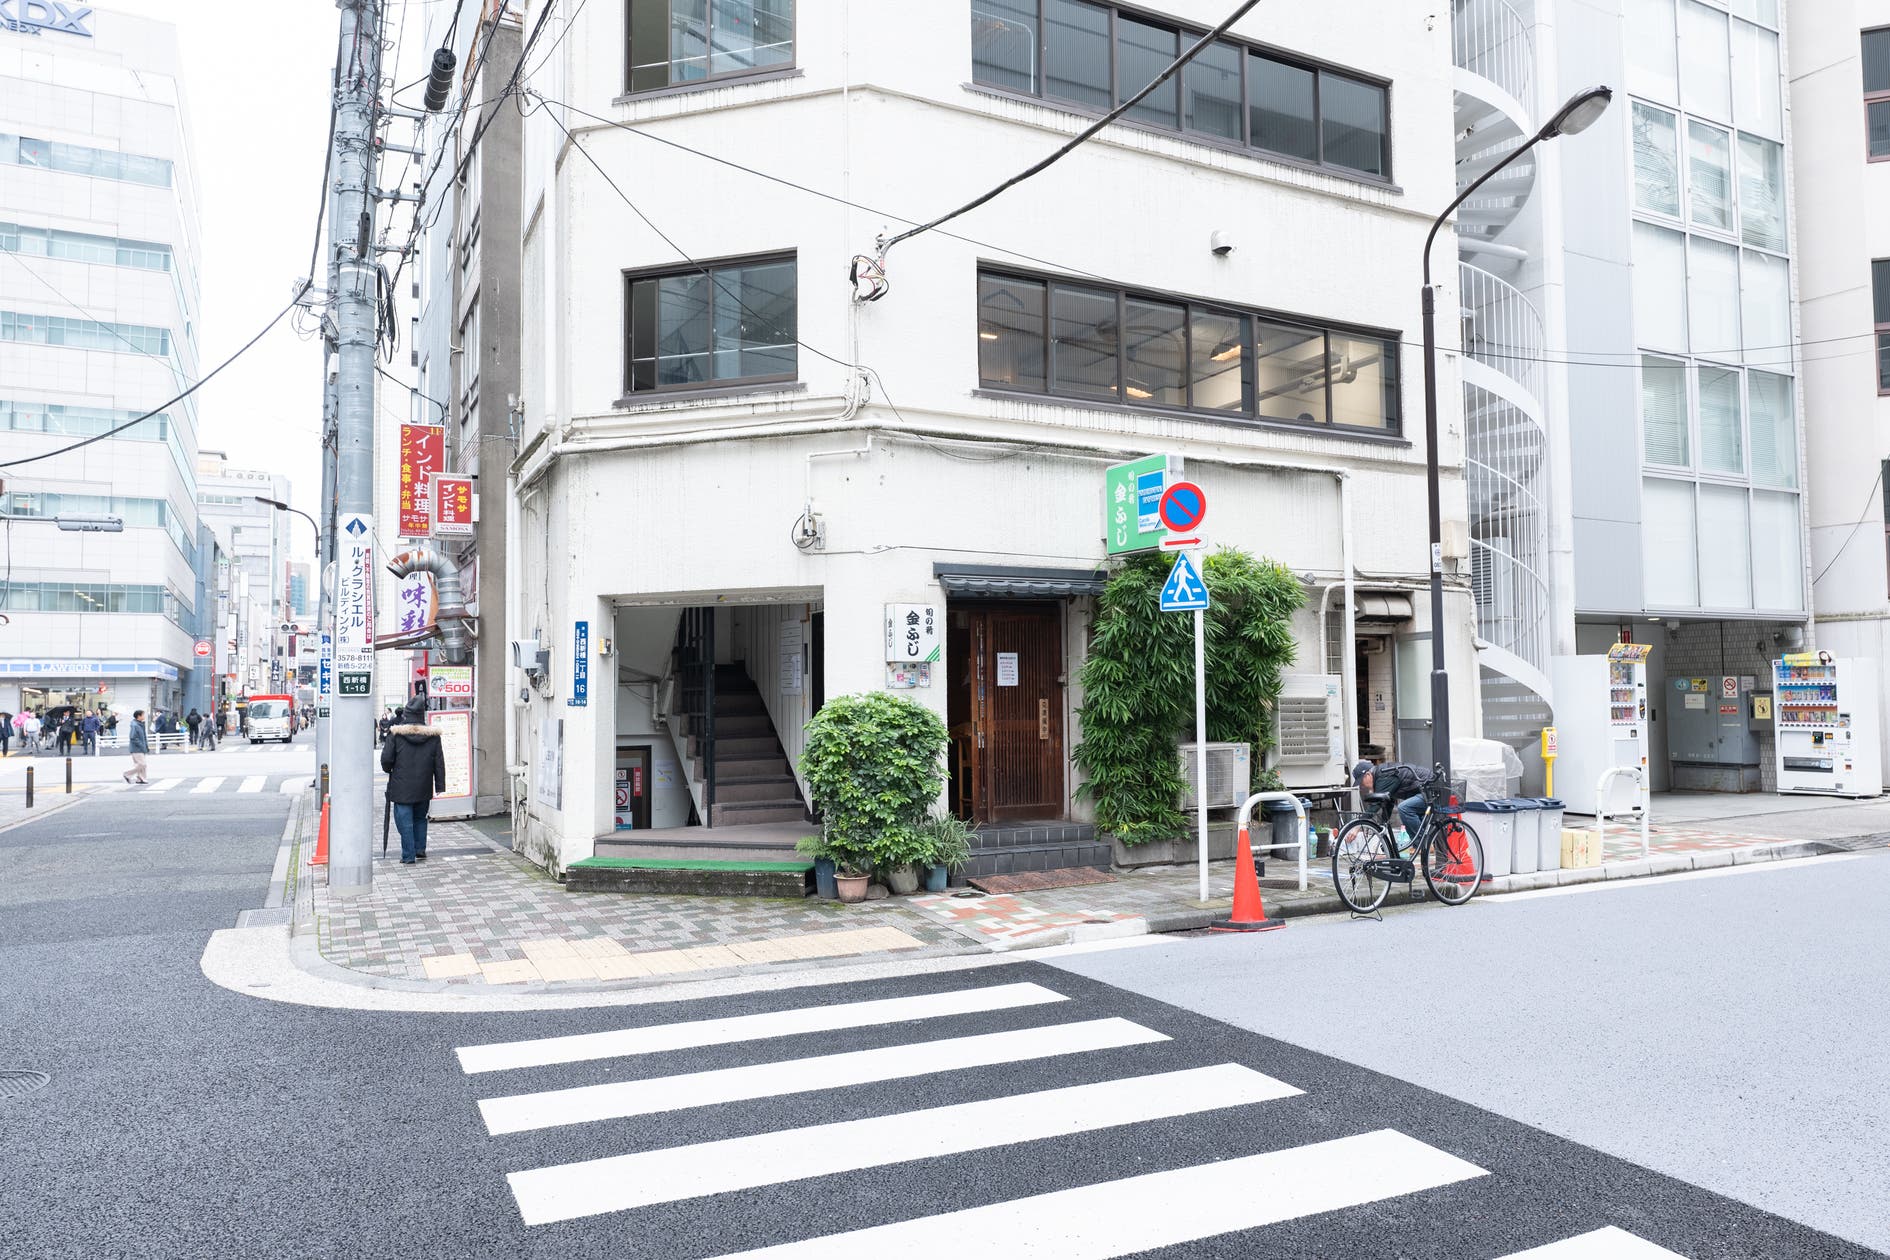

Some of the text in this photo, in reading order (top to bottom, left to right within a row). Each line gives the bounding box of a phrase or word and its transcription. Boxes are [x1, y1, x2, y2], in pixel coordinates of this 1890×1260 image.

[402, 426, 412, 510] ランチ・食事・弁当
[414, 434, 432, 513] インド料理
[442, 483, 456, 522] インド料理
[457, 485, 468, 513] サモサ
[1115, 482, 1127, 546] 金ふじ
[402, 514, 428, 523] サモサ
[351, 546, 364, 627] ル・グラシエル
[906, 610, 920, 657] 金ふじ
[40, 663, 94, 672] LAWSON
[321, 659, 331, 693] セキネ
[345, 684, 366, 692] 1-16
[576, 684, 586, 693] 16
